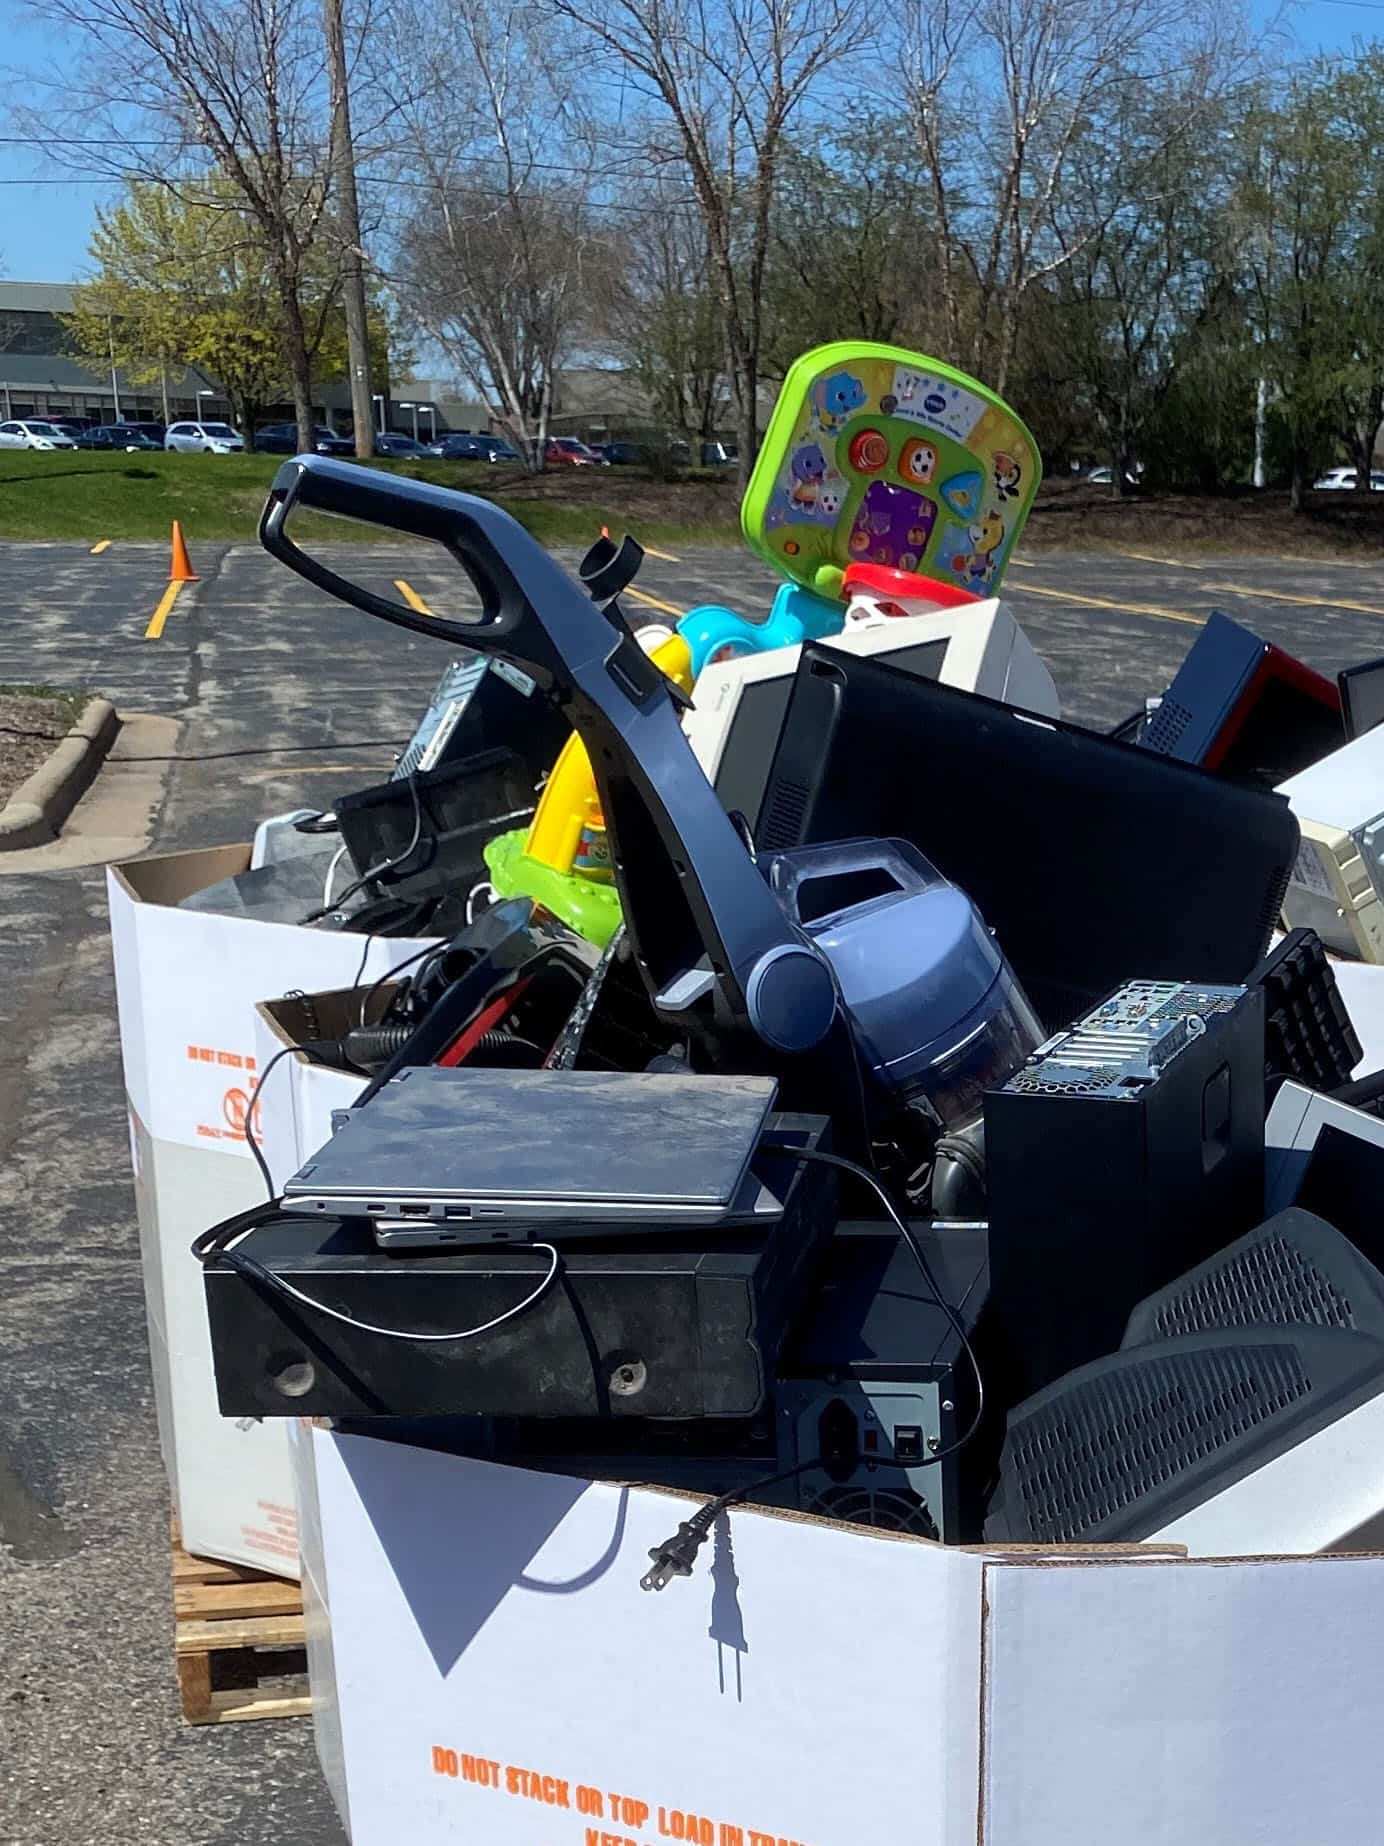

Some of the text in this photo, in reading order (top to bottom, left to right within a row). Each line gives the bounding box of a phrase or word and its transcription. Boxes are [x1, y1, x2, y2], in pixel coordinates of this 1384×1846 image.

[431, 1745, 459, 1777] DO
[460, 1753, 500, 1789] NOT
[505, 1765, 570, 1809] STACK
[575, 1784, 604, 1819] OR
[607, 1792, 649, 1829] TOP
[657, 1806, 715, 1846] LOAD
[719, 1823, 744, 1846] IN
